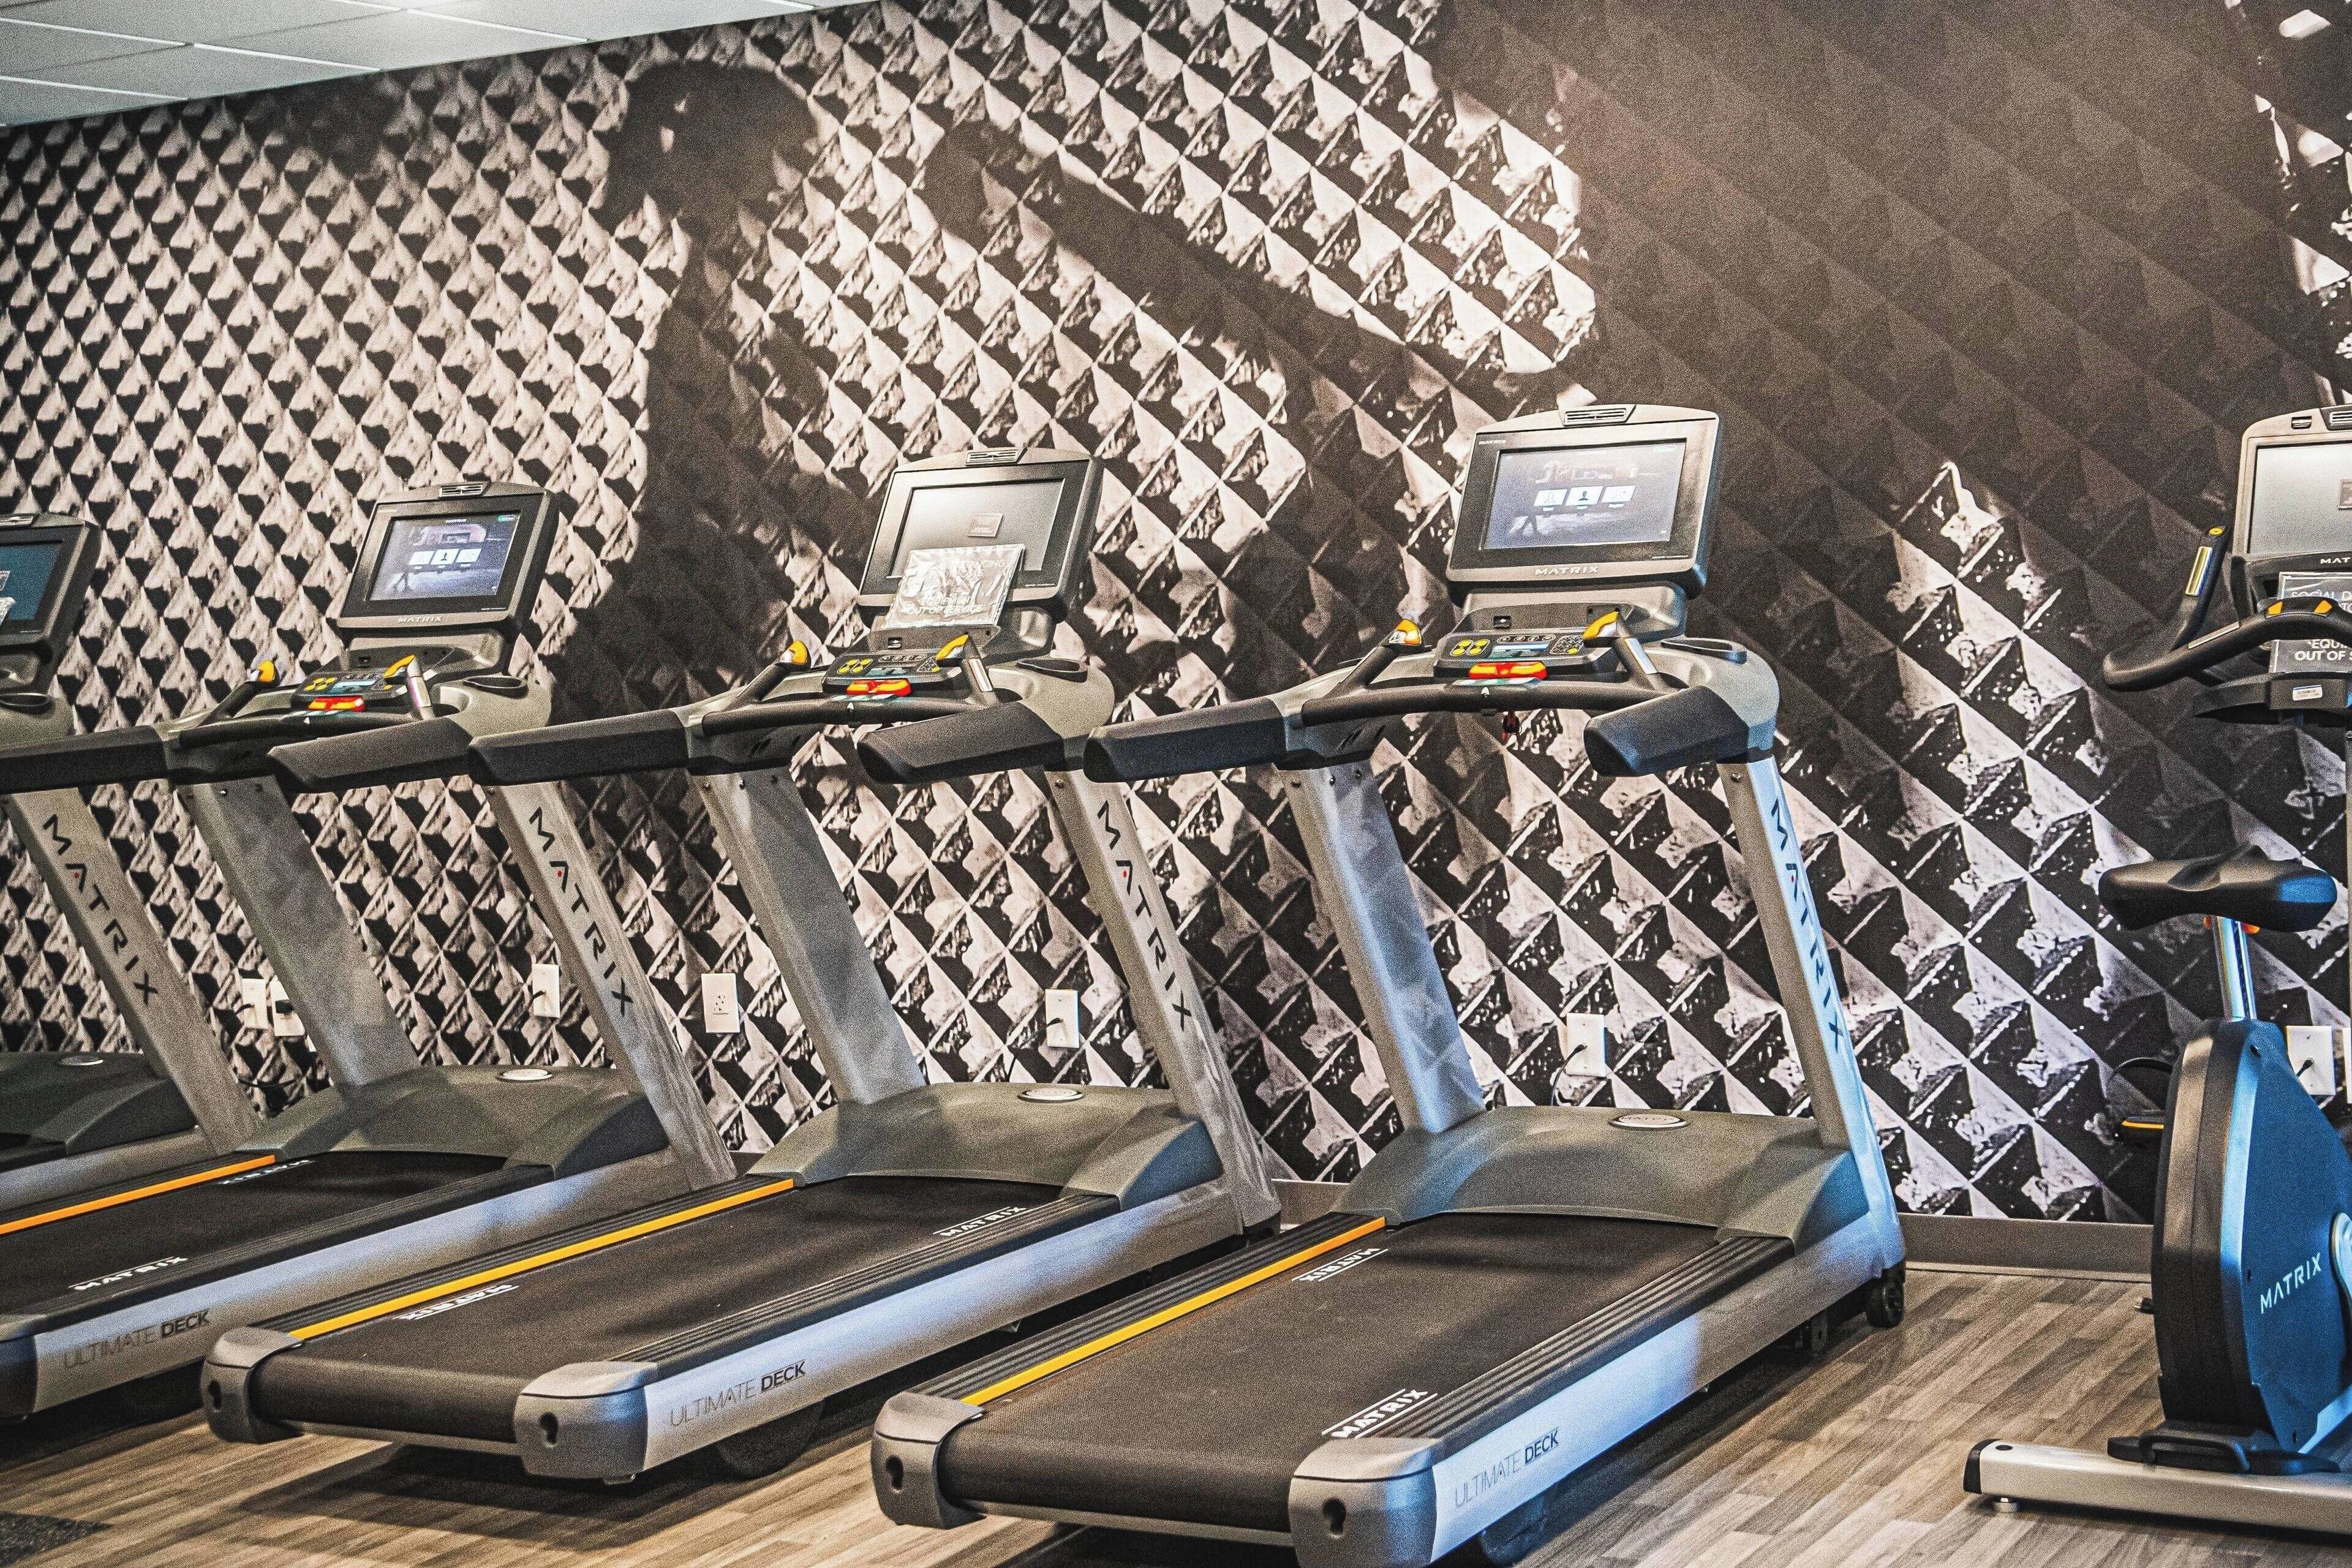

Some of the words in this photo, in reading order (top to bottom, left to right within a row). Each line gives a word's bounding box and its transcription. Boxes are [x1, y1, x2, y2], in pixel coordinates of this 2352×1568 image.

[1535, 566, 1599, 576] MATRIX
[398, 615, 443, 624] MATRIX
[2294, 650, 2323, 661] OUT
[2327, 650, 2346, 661] OF
[42, 813, 159, 1006] MATRIX
[529, 805, 634, 1017] MATRIX
[1097, 800, 1192, 1031] MATRIX
[1771, 798, 1844, 1054] MATRIX
[940, 1207, 1027, 1237] MATRIX
[1299, 1248, 1381, 1281] MATRIX
[2260, 1252, 2321, 1314] MATRIX
[64, 1326, 155, 1369] ULTIMATE
[160, 1309, 210, 1339] DECK
[669, 1378, 756, 1427] ULTIMATE
[761, 1360, 806, 1392] DECK
[1331, 1389, 1428, 1438] MATRIX
[1455, 1449, 1521, 1508] ULTIMATE
[1525, 1429, 1559, 1465] DECK
